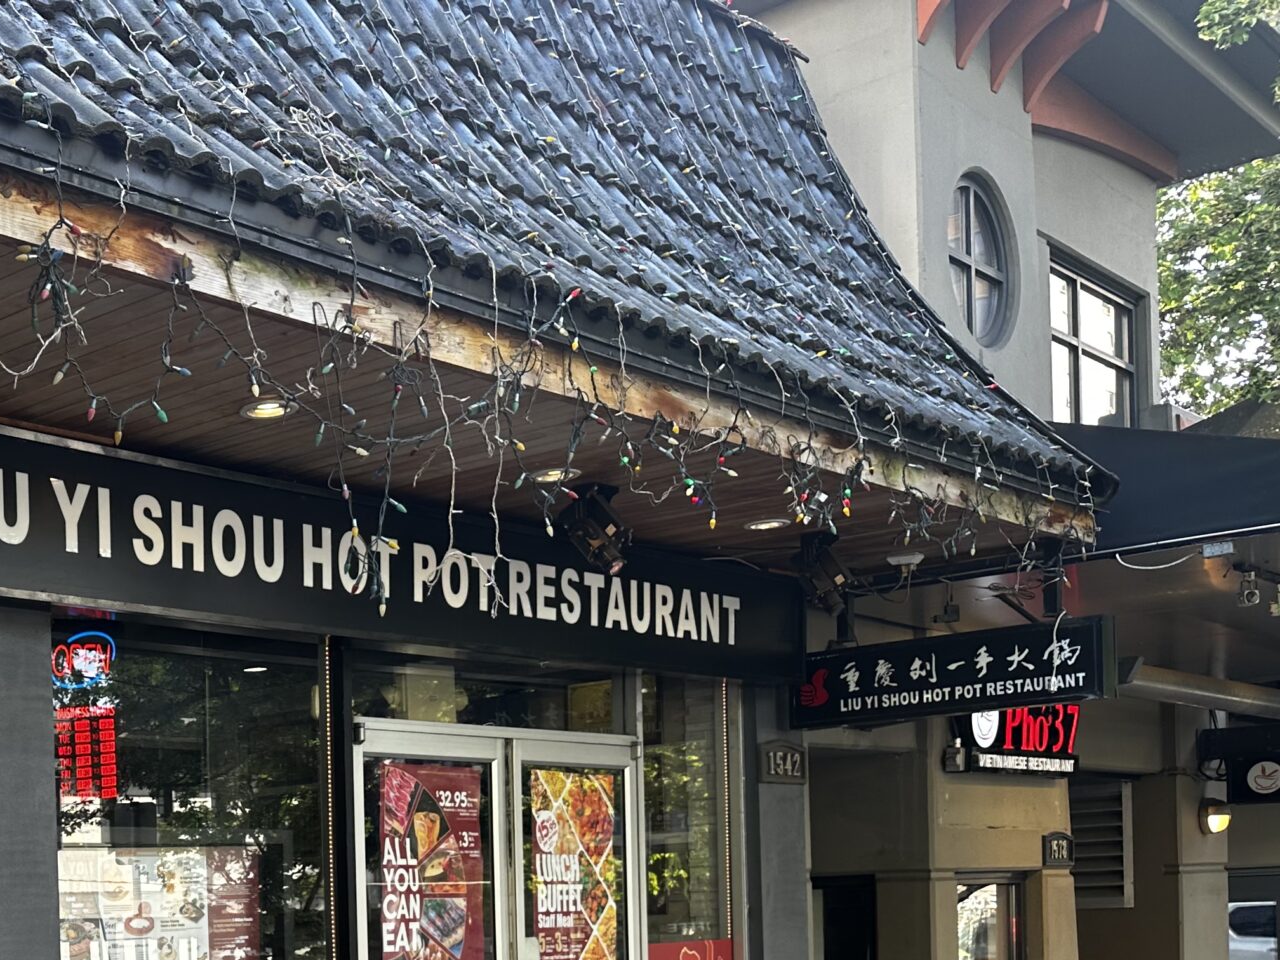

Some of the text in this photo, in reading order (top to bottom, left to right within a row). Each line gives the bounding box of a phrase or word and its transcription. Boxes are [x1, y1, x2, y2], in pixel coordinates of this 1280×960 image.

[49, 477, 112, 558] YI
[132, 494, 285, 584] SHOU
[302, 523, 399, 599] HOT
[413, 542, 496, 612] POT
[508, 558, 741, 646] RESTAURANT
[51, 643, 111, 677] OPEN
[840, 672, 1086, 712] LIU YI SHOU HOT POT RESTAURANT
[768, 751, 801, 776] 1542
[978, 753, 1075, 773] VIETNAMESE RESTAURANT
[435, 790, 468, 808] $32.95
[382, 837, 418, 866] ALL
[383, 868, 420, 892] YOU
[535, 853, 580, 883] LUNCH
[382, 893, 421, 920] CAN
[536, 884, 583, 913] BUFFET
[538, 913, 556, 928] Staff
[557, 913, 574, 928] Meal
[382, 921, 422, 953] EAT
